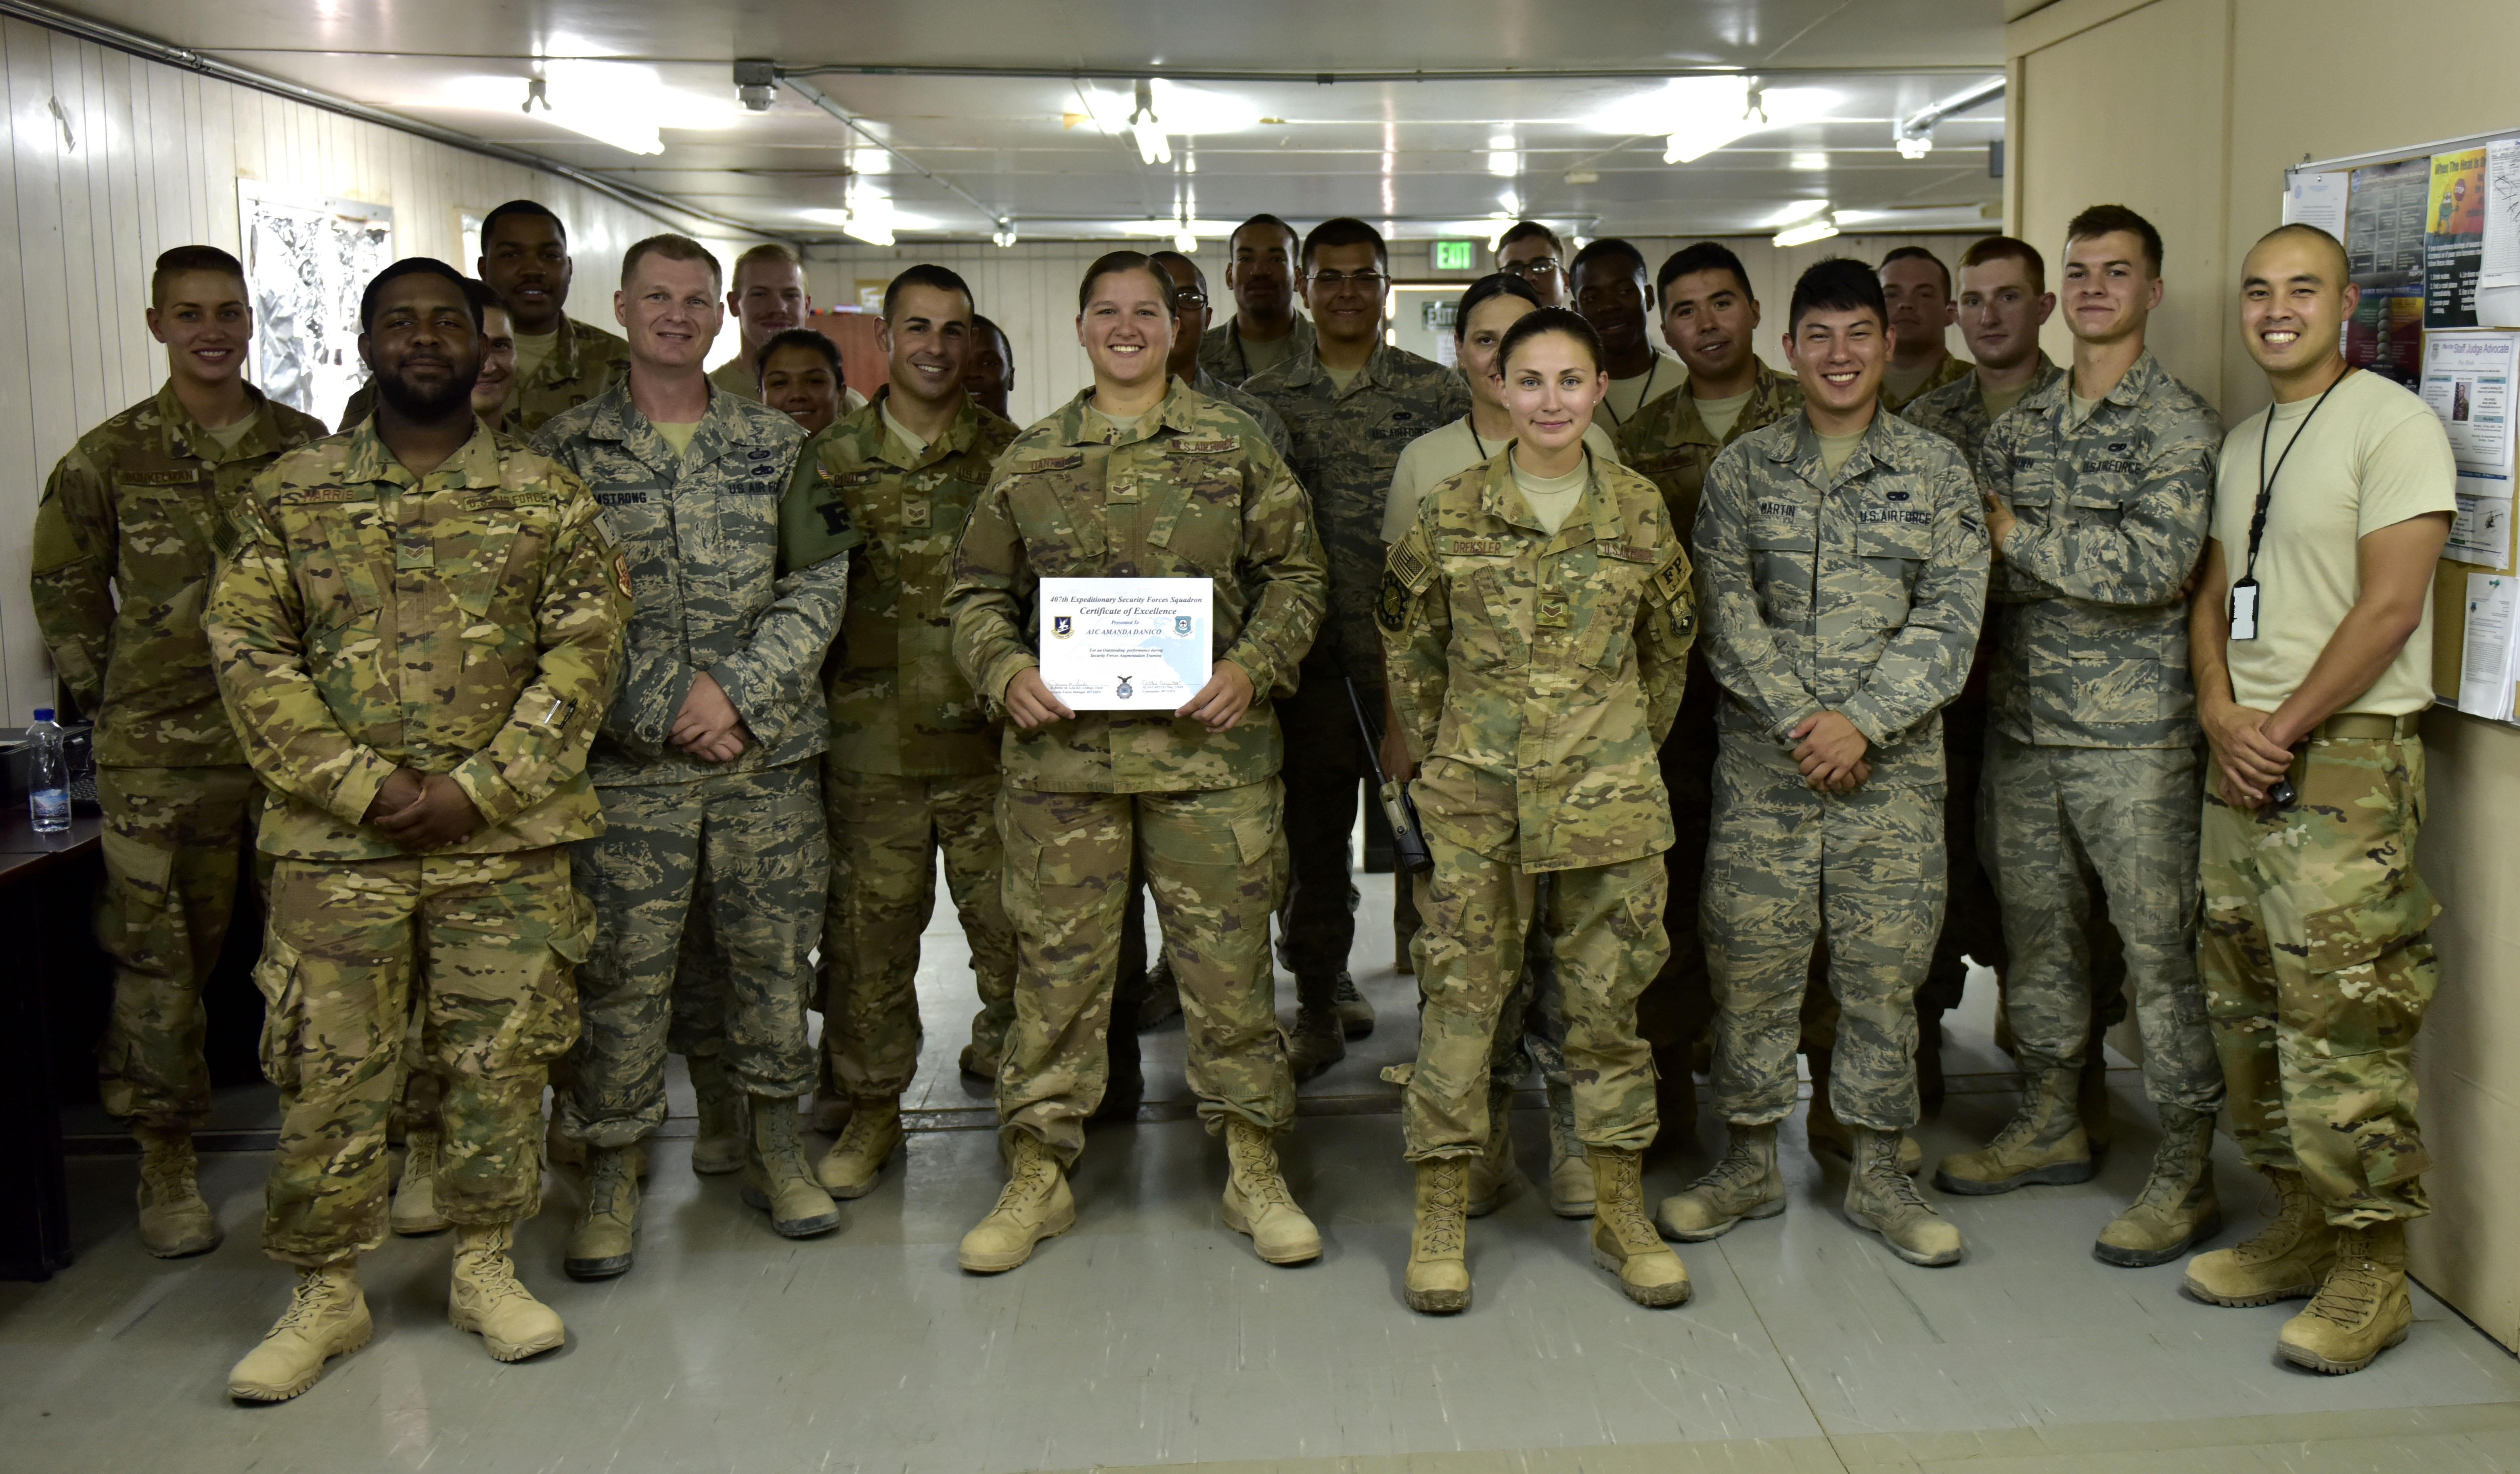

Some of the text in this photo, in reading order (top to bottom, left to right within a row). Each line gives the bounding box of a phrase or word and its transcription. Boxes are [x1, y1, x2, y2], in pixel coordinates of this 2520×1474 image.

[1437, 242, 1471, 269] EXIT
[2466, 343, 2483, 355] Judge
[2483, 343, 2509, 353] Advocate
[1195, 442, 1208, 452] AIR
[2016, 456, 2034, 469] OWN
[2109, 460, 2141, 474] FORCE
[749, 482, 766, 493] AIR
[303, 490, 354, 502] HARRIS
[492, 496, 512, 506] AIR
[513, 493, 548, 506] FORCE
[594, 492, 647, 505] MSTRONG
[1760, 502, 1796, 517] MARTIN
[1860, 510, 1932, 524] U.S. AIR FORCE
[1453, 541, 1501, 554] DREKSLER
[1662, 557, 1682, 585] FP
[1080, 607, 1121, 616] Certificate
[1123, 607, 1133, 616] of
